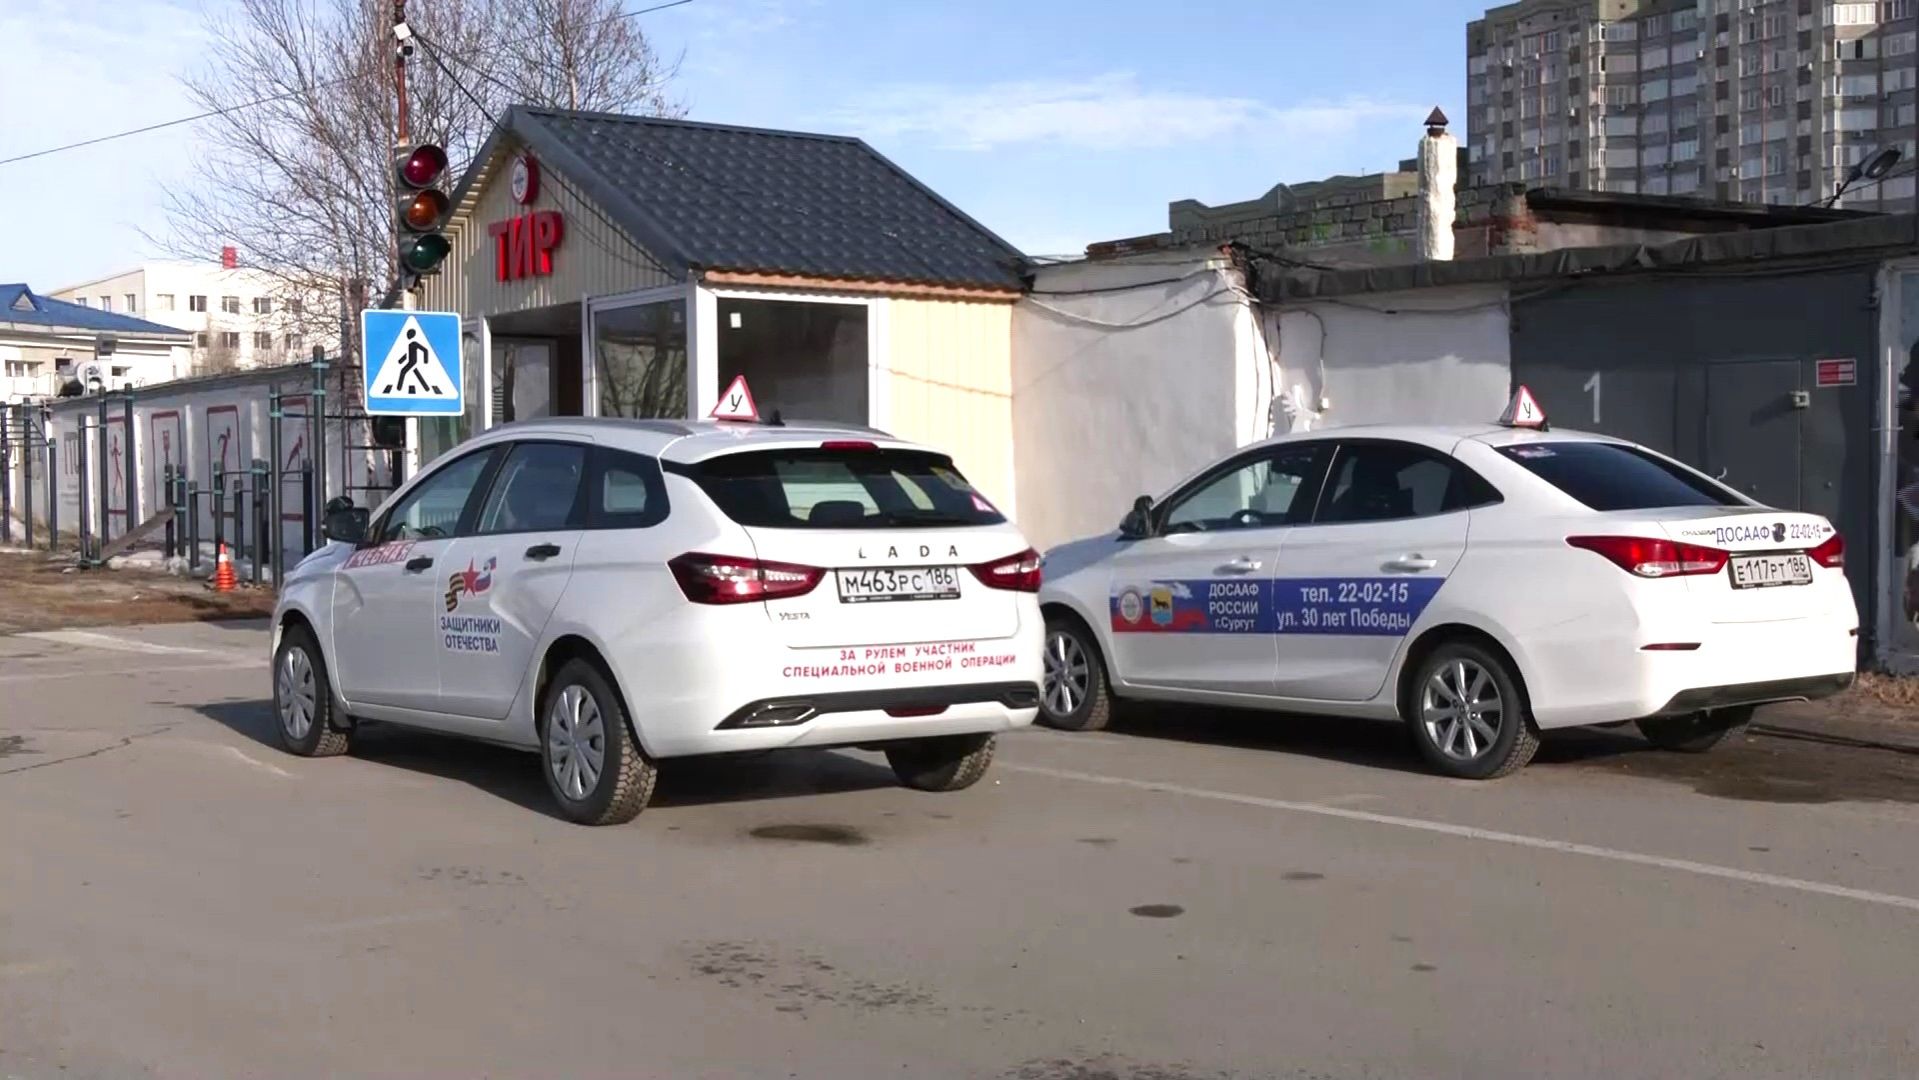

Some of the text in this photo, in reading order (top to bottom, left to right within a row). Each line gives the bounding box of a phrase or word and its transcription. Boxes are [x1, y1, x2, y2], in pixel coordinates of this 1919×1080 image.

[487, 211, 563, 283] ТИР
[1584, 371, 1600, 423] 1
[1716, 526, 1770, 545] ДОСААФ
[1790, 524, 1821, 539] 22-02-15
[858, 545, 958, 559] LADA
[1209, 583, 1259, 599] ДОСААФ
[1300, 583, 1409, 603] тел. 22-02-15
[1209, 601, 1258, 615] РОССИИ
[441, 616, 501, 633] ЗАЩИТНИКИ
[1277, 608, 1410, 630] ул. 30 лет Победы
[445, 635, 498, 652] ОТЕЧЕСТВА
[840, 643, 976, 661] ЗА РУЛЕМ УЧАСТНИК
[782, 655, 1016, 679] СПЕЦИАЛЬНОЙ ВОЕННОЙ ОПЕРАЦИИ
